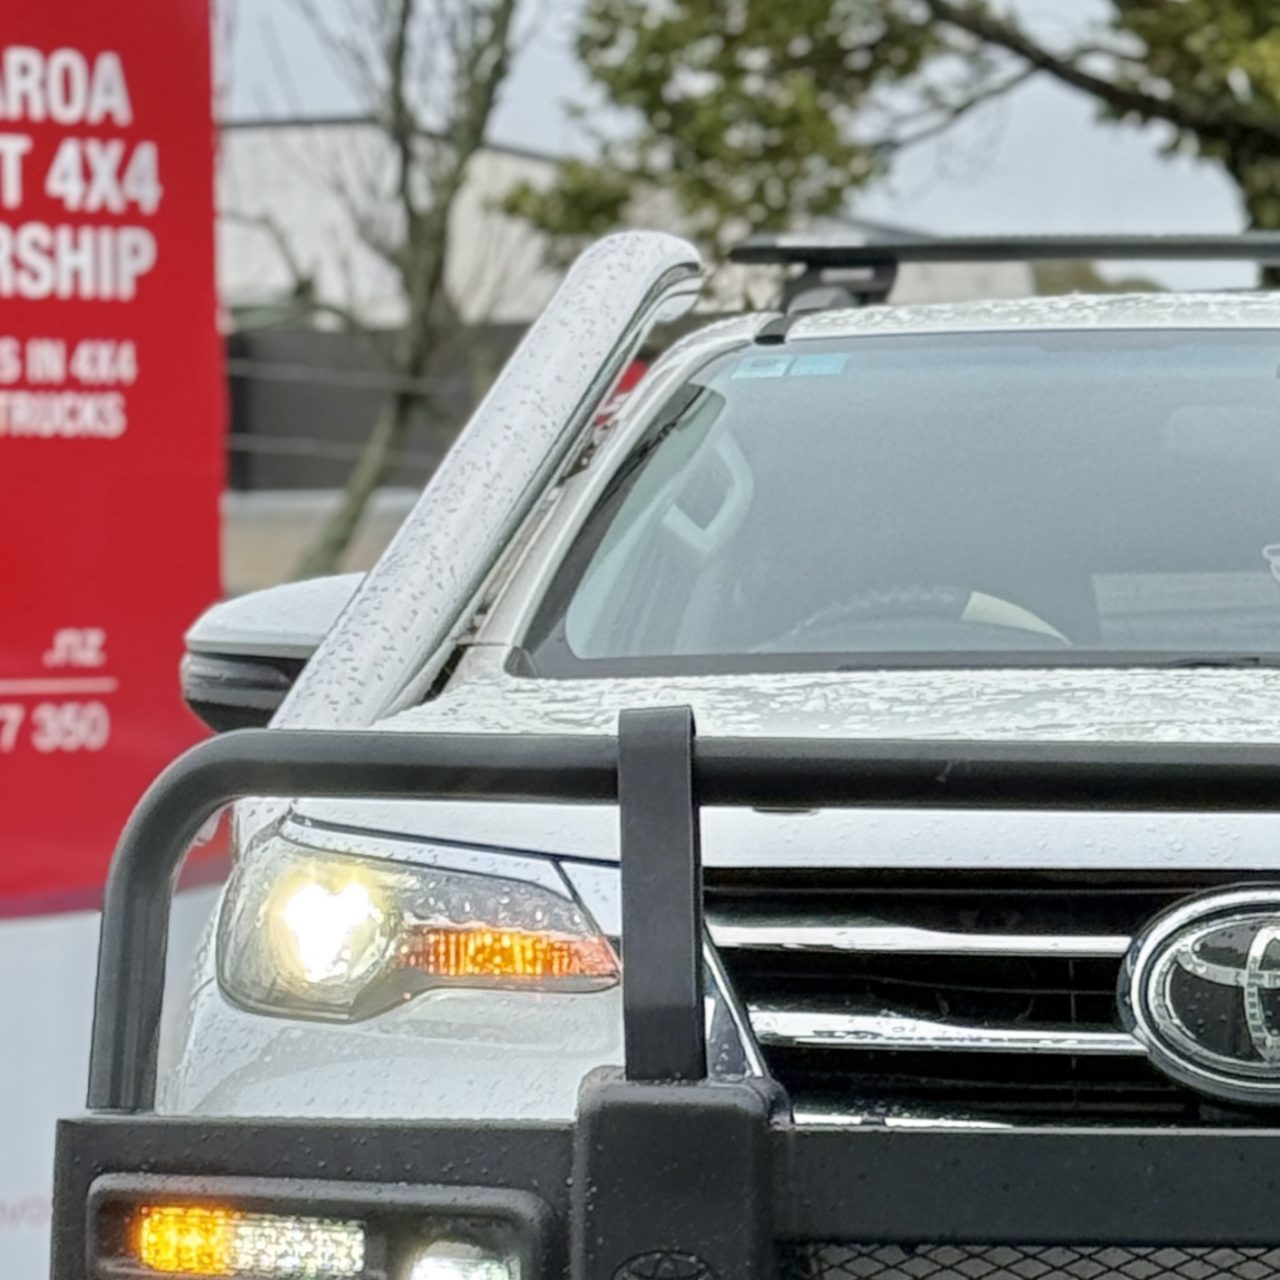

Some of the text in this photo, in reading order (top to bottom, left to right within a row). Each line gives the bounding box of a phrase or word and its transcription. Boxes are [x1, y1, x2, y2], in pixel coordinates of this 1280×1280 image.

[0, 45, 134, 127] ROA
[45, 136, 164, 216] 4X4
[25, 337, 67, 385] IN
[31, 701, 111, 753] 350
